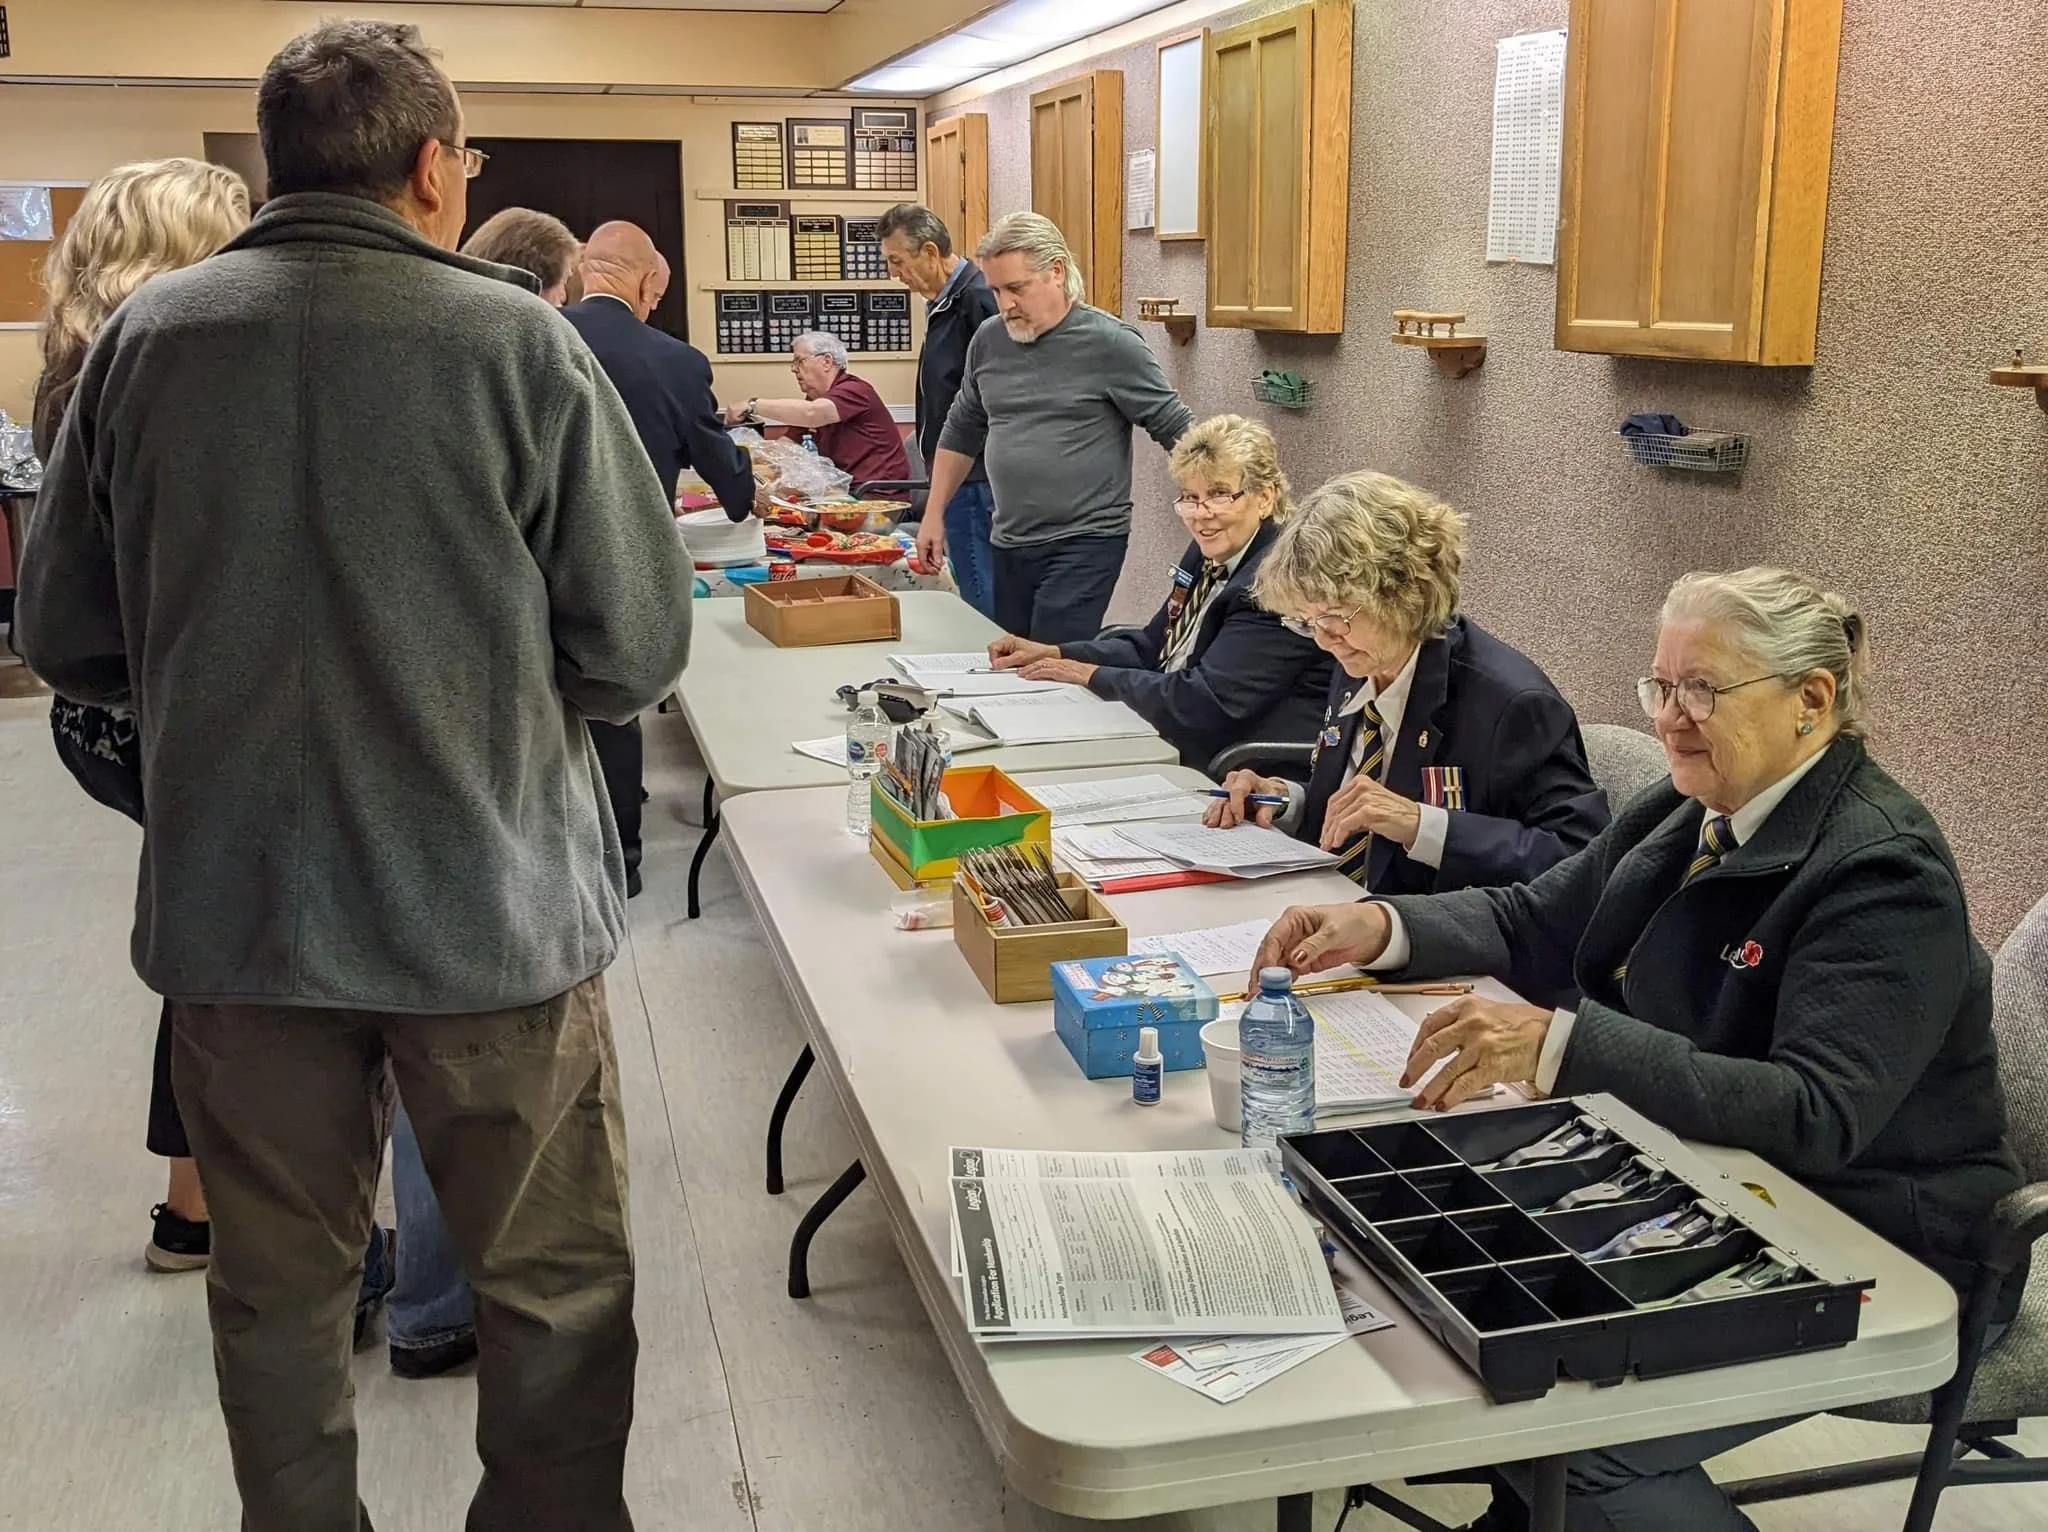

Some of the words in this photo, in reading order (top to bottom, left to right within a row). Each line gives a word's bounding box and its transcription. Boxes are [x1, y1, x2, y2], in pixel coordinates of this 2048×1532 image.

[965, 1190, 981, 1210] Legion
[982, 1238, 996, 1269] Membership
[988, 1269, 999, 1281] For
[1055, 1272, 1065, 1285] Type
[990, 1280, 1005, 1321] Application
[1057, 1285, 1069, 1319] Membership
[1189, 1283, 1201, 1317] Membership
